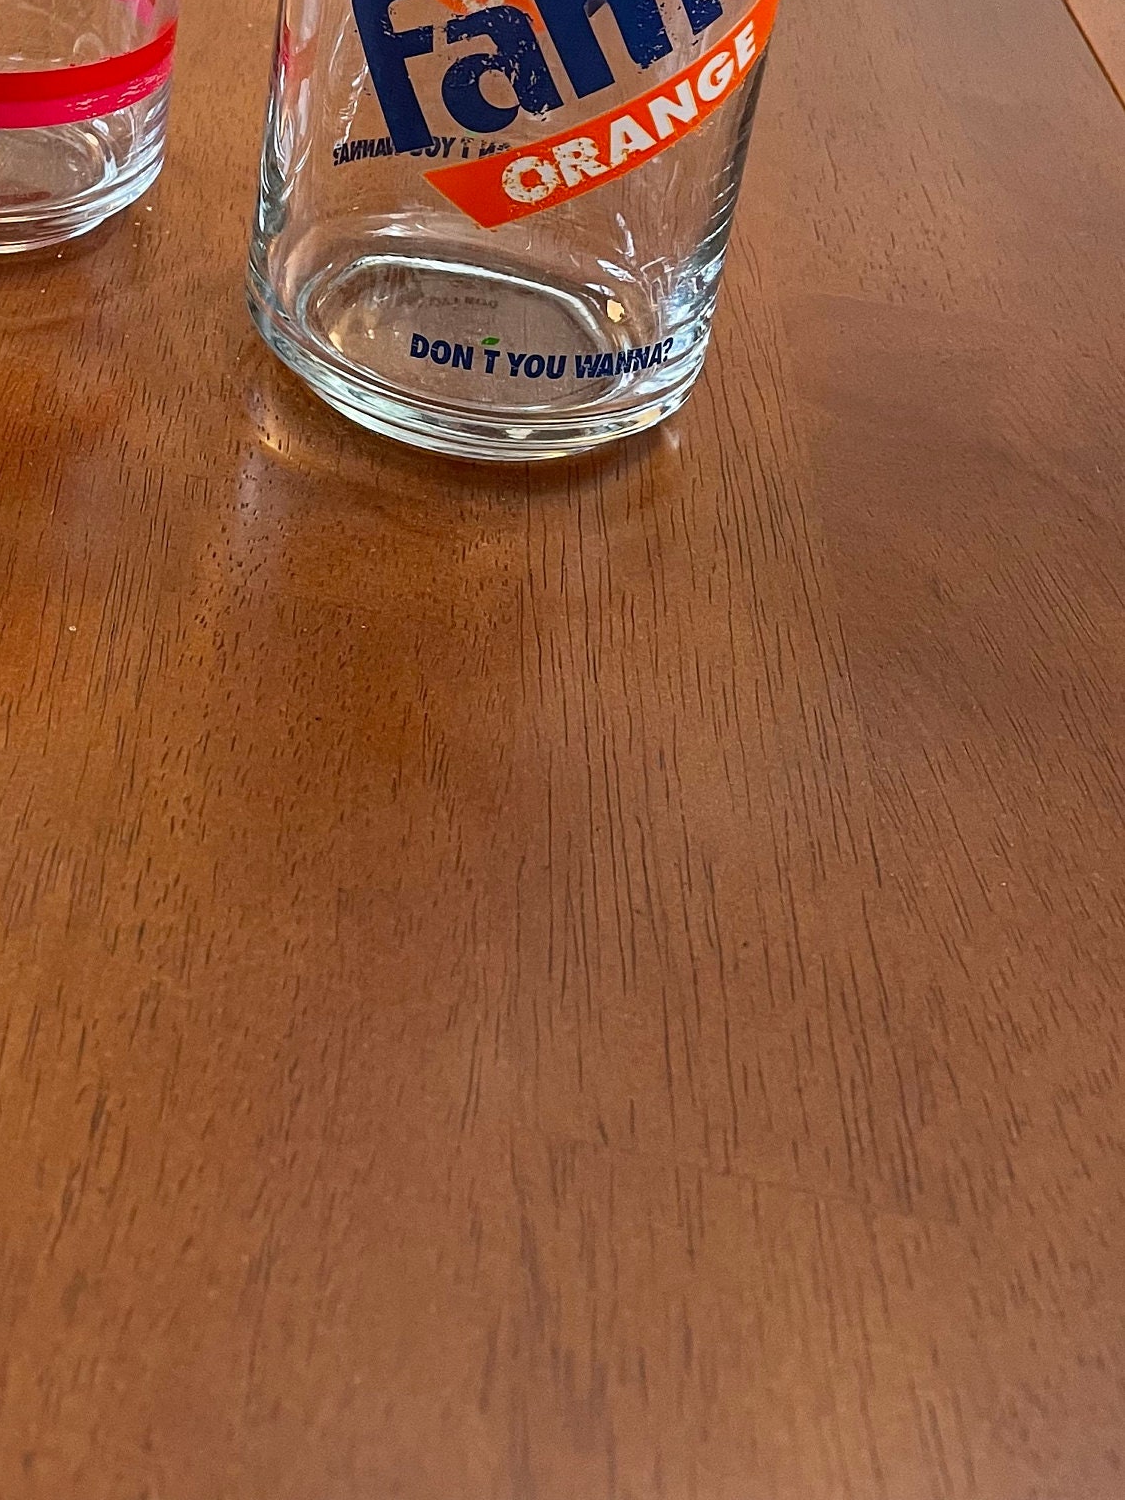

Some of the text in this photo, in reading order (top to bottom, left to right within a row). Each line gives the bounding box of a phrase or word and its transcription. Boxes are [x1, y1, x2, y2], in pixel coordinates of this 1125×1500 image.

[501, 19, 756, 204] ORANGE
[507, 352, 567, 379] YOU
[575, 337, 674, 379] WANNA?
